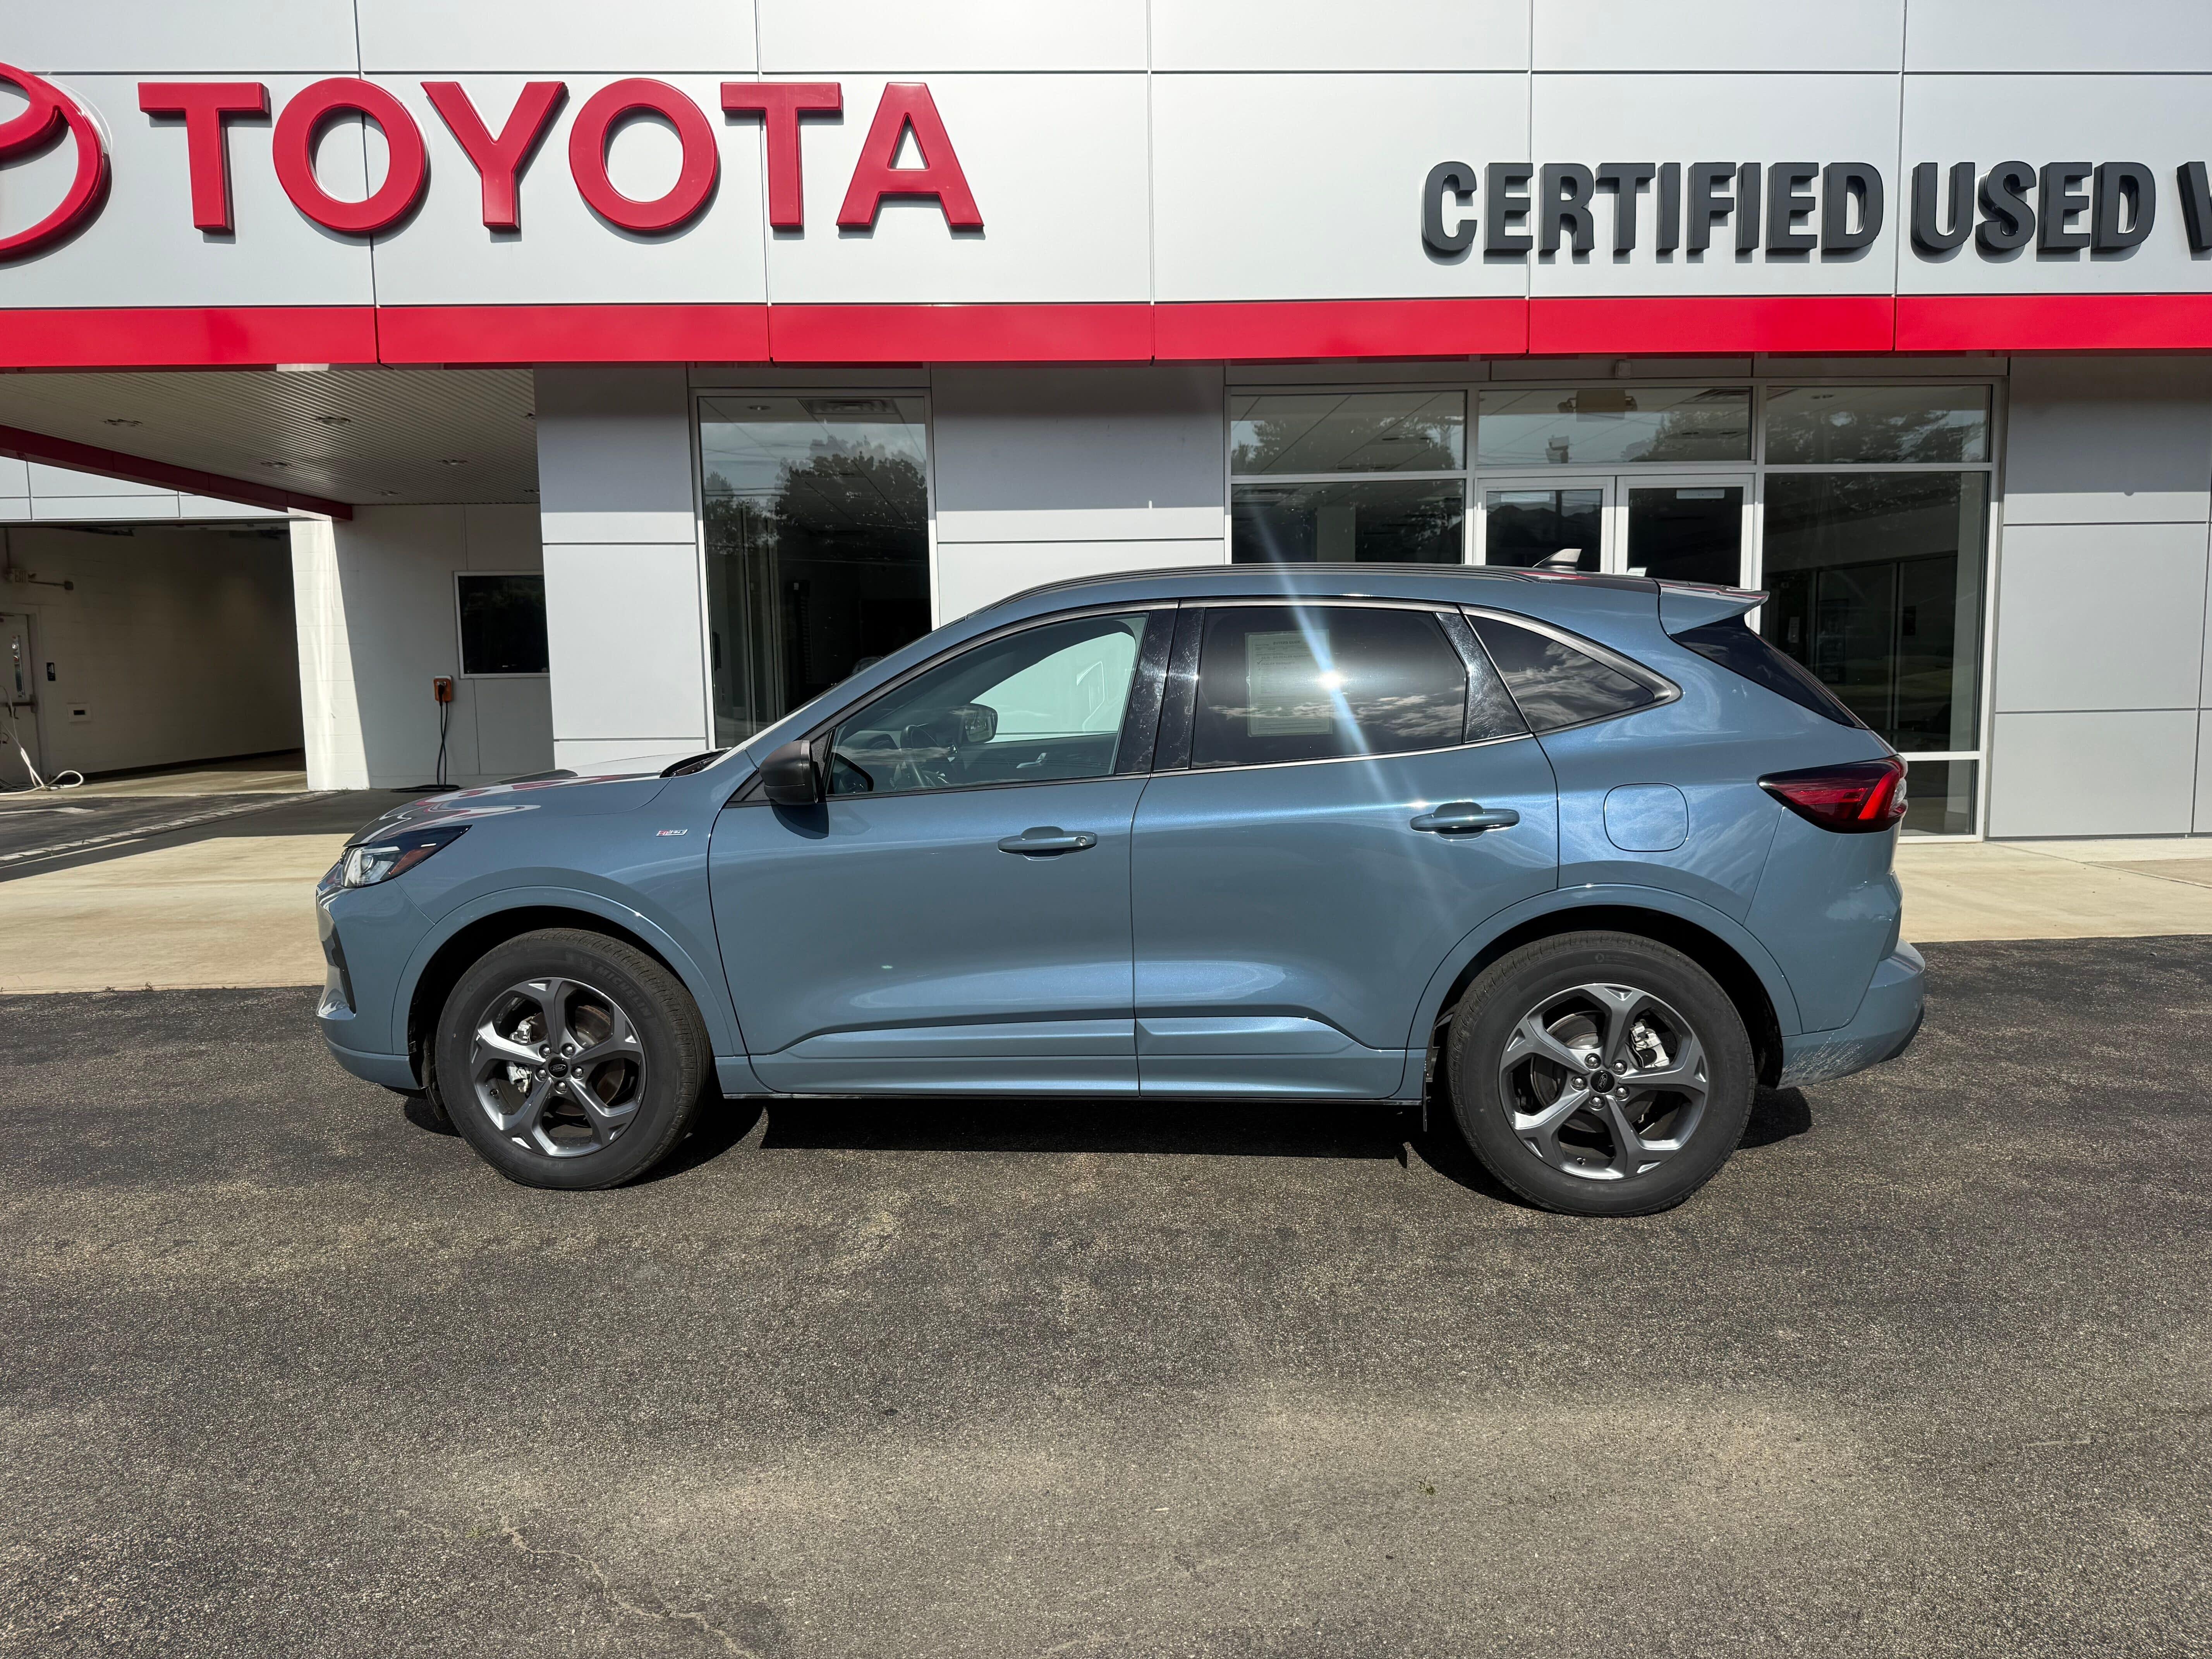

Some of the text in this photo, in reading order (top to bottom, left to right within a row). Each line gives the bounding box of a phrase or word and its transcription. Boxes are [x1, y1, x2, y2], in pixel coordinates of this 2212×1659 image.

[137, 77, 984, 233] TOYOTA
[1422, 161, 1884, 252] CERTIFIED
[1911, 161, 2156, 252] USED
[596, 967, 651, 1016] MICHELIN
